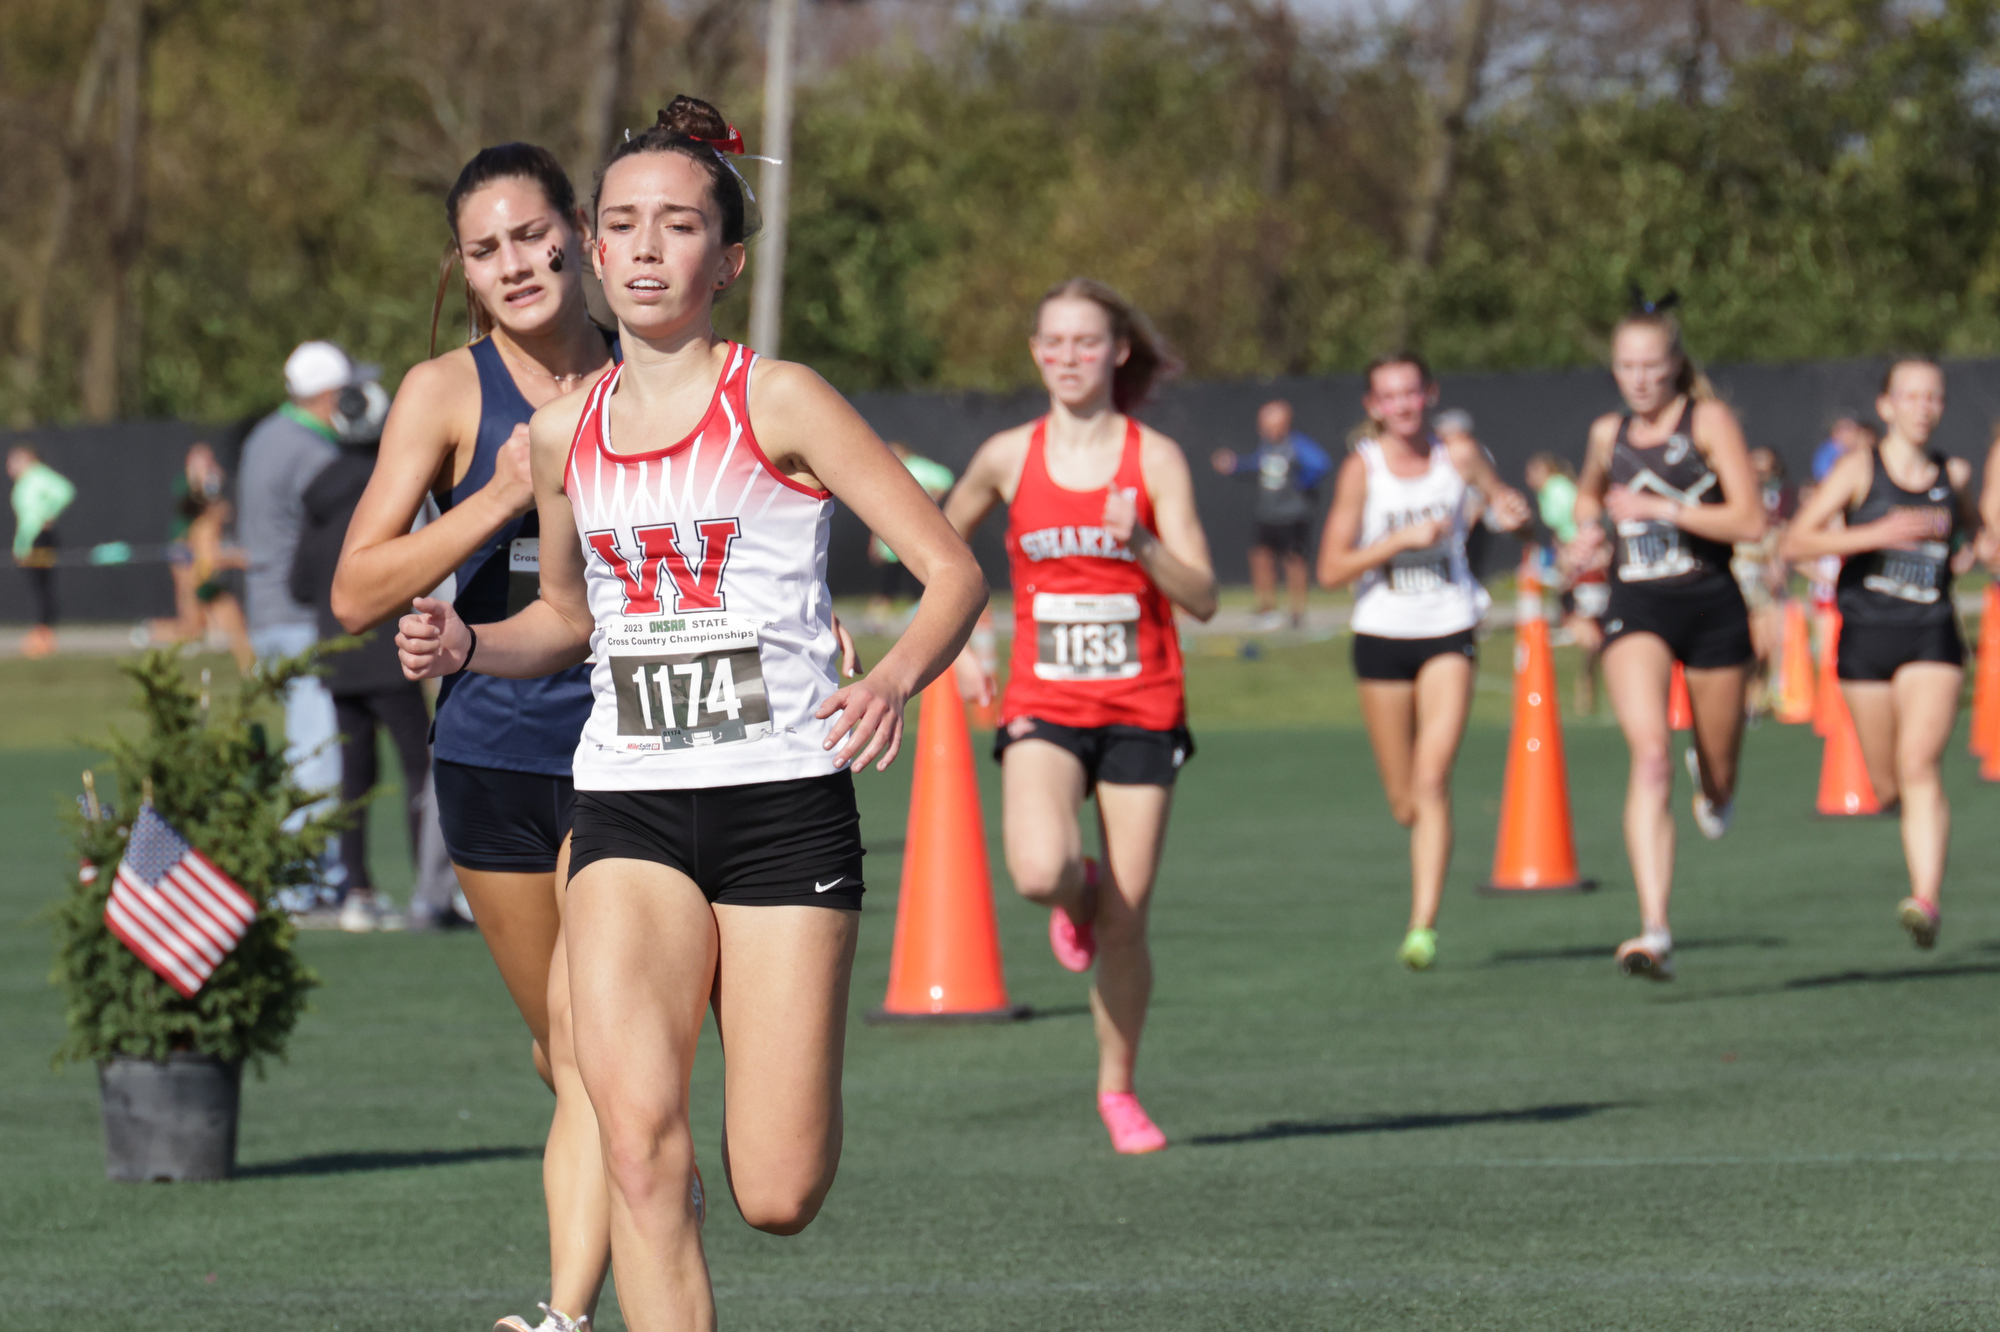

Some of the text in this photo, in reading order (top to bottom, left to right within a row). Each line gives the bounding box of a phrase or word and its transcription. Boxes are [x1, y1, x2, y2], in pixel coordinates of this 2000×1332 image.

[513, 553, 539, 562] Cros
[585, 517, 742, 617] W
[607, 629, 754, 646] Cross Country Championships
[624, 618, 728, 633] 2023 OHSAA STATE
[1052, 622, 1127, 666] 1133
[632, 657, 743, 730] 1174
